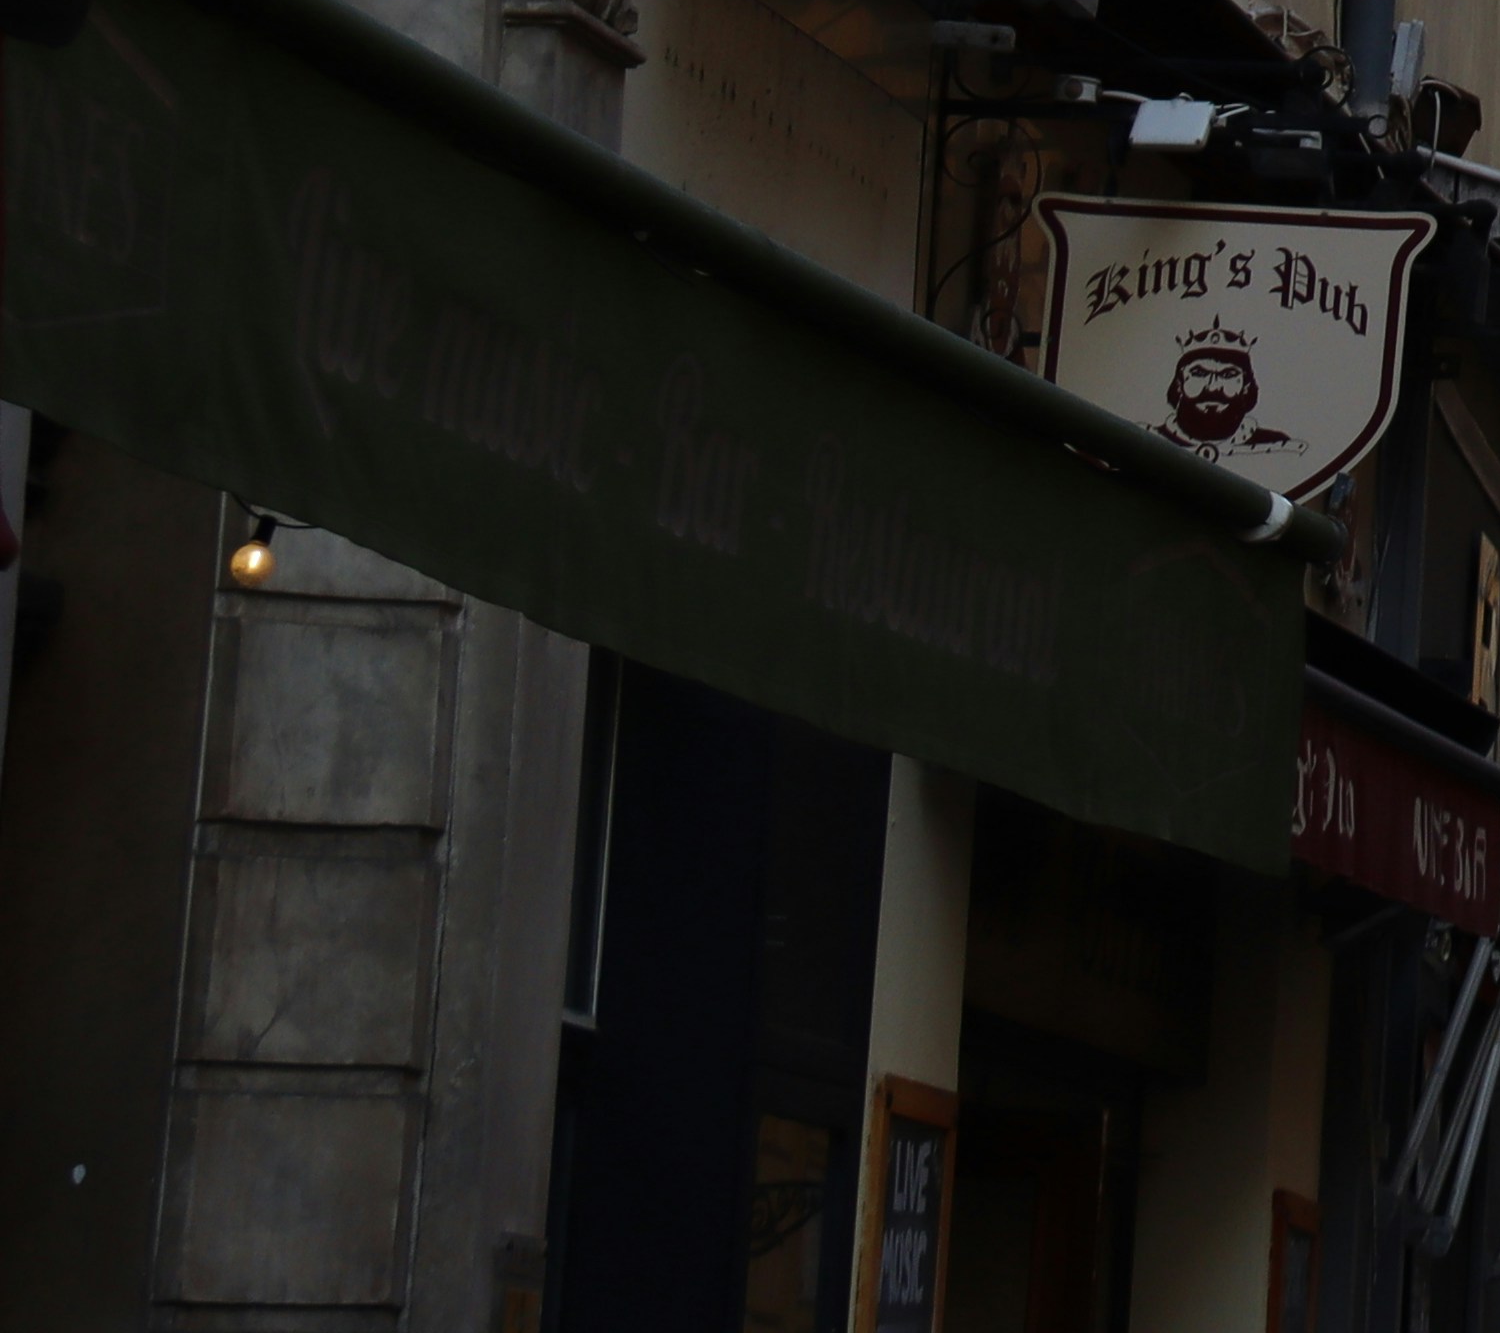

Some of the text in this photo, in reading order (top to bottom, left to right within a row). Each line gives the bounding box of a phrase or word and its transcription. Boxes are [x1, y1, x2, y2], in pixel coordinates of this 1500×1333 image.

[1083, 238, 1256, 326] King's
[1268, 246, 1369, 337] Pub
[655, 352, 761, 557] Bar
[881, 1138, 932, 1307] LIVE MUSIC
